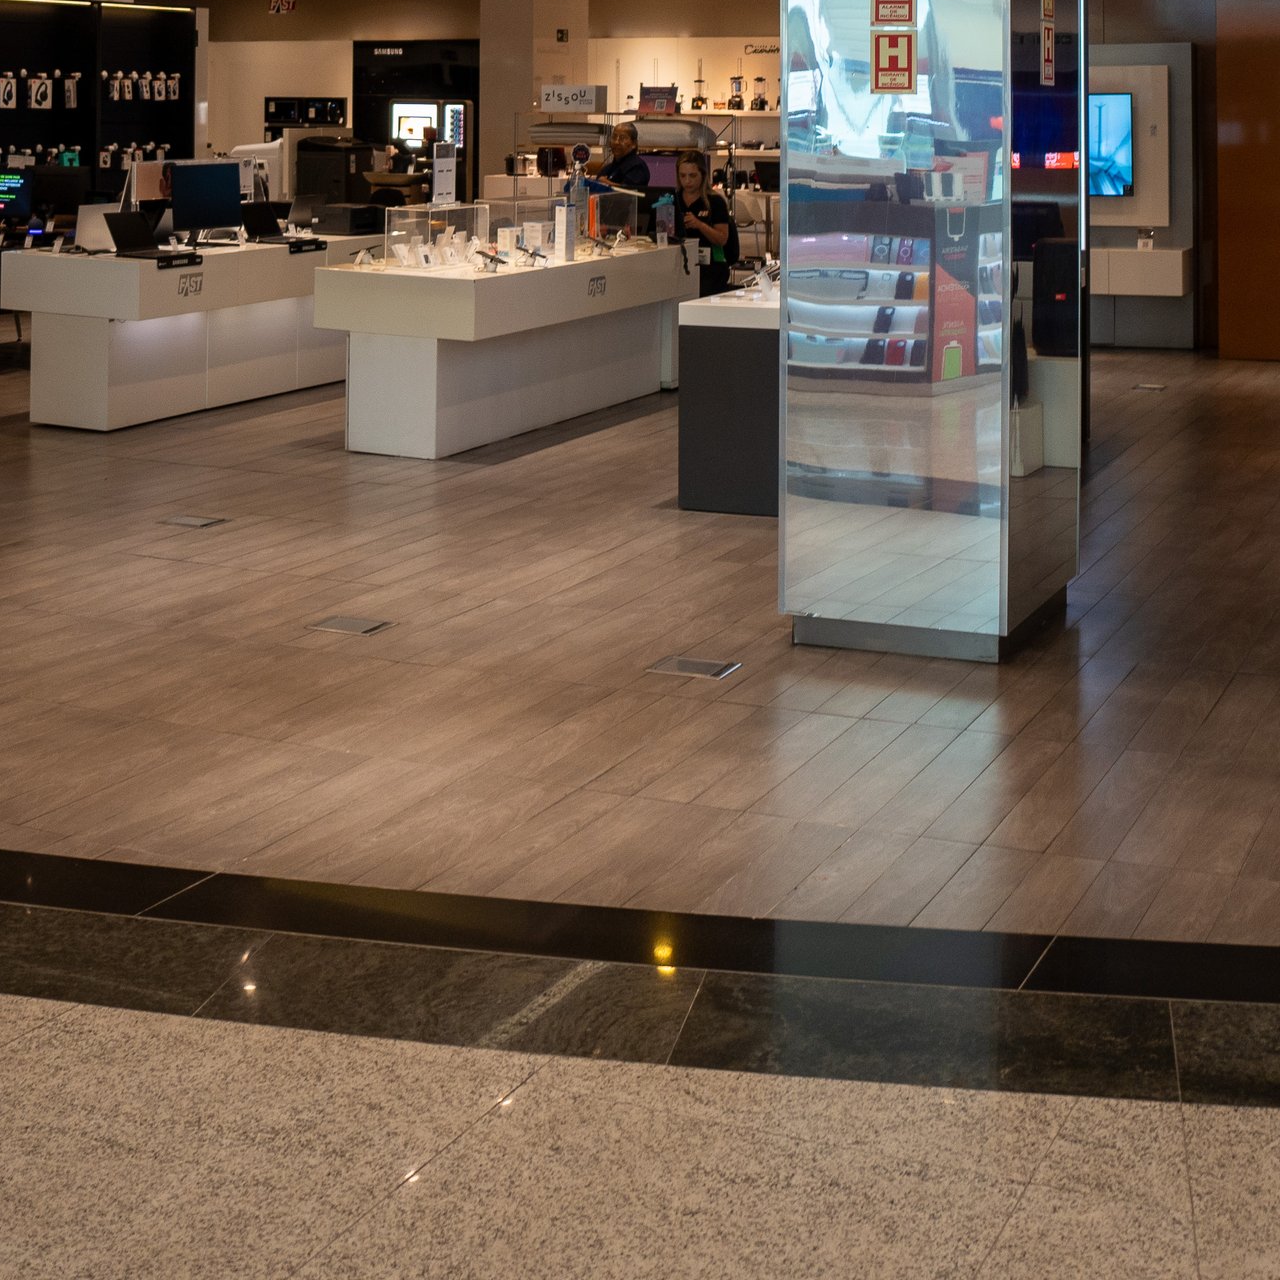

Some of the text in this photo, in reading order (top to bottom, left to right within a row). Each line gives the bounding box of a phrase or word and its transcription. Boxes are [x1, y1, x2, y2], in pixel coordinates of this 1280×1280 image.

[374, 48, 403, 56] SAMSUNG
[879, 37, 908, 69] H
[545, 90, 587, 105] ZISSOU
